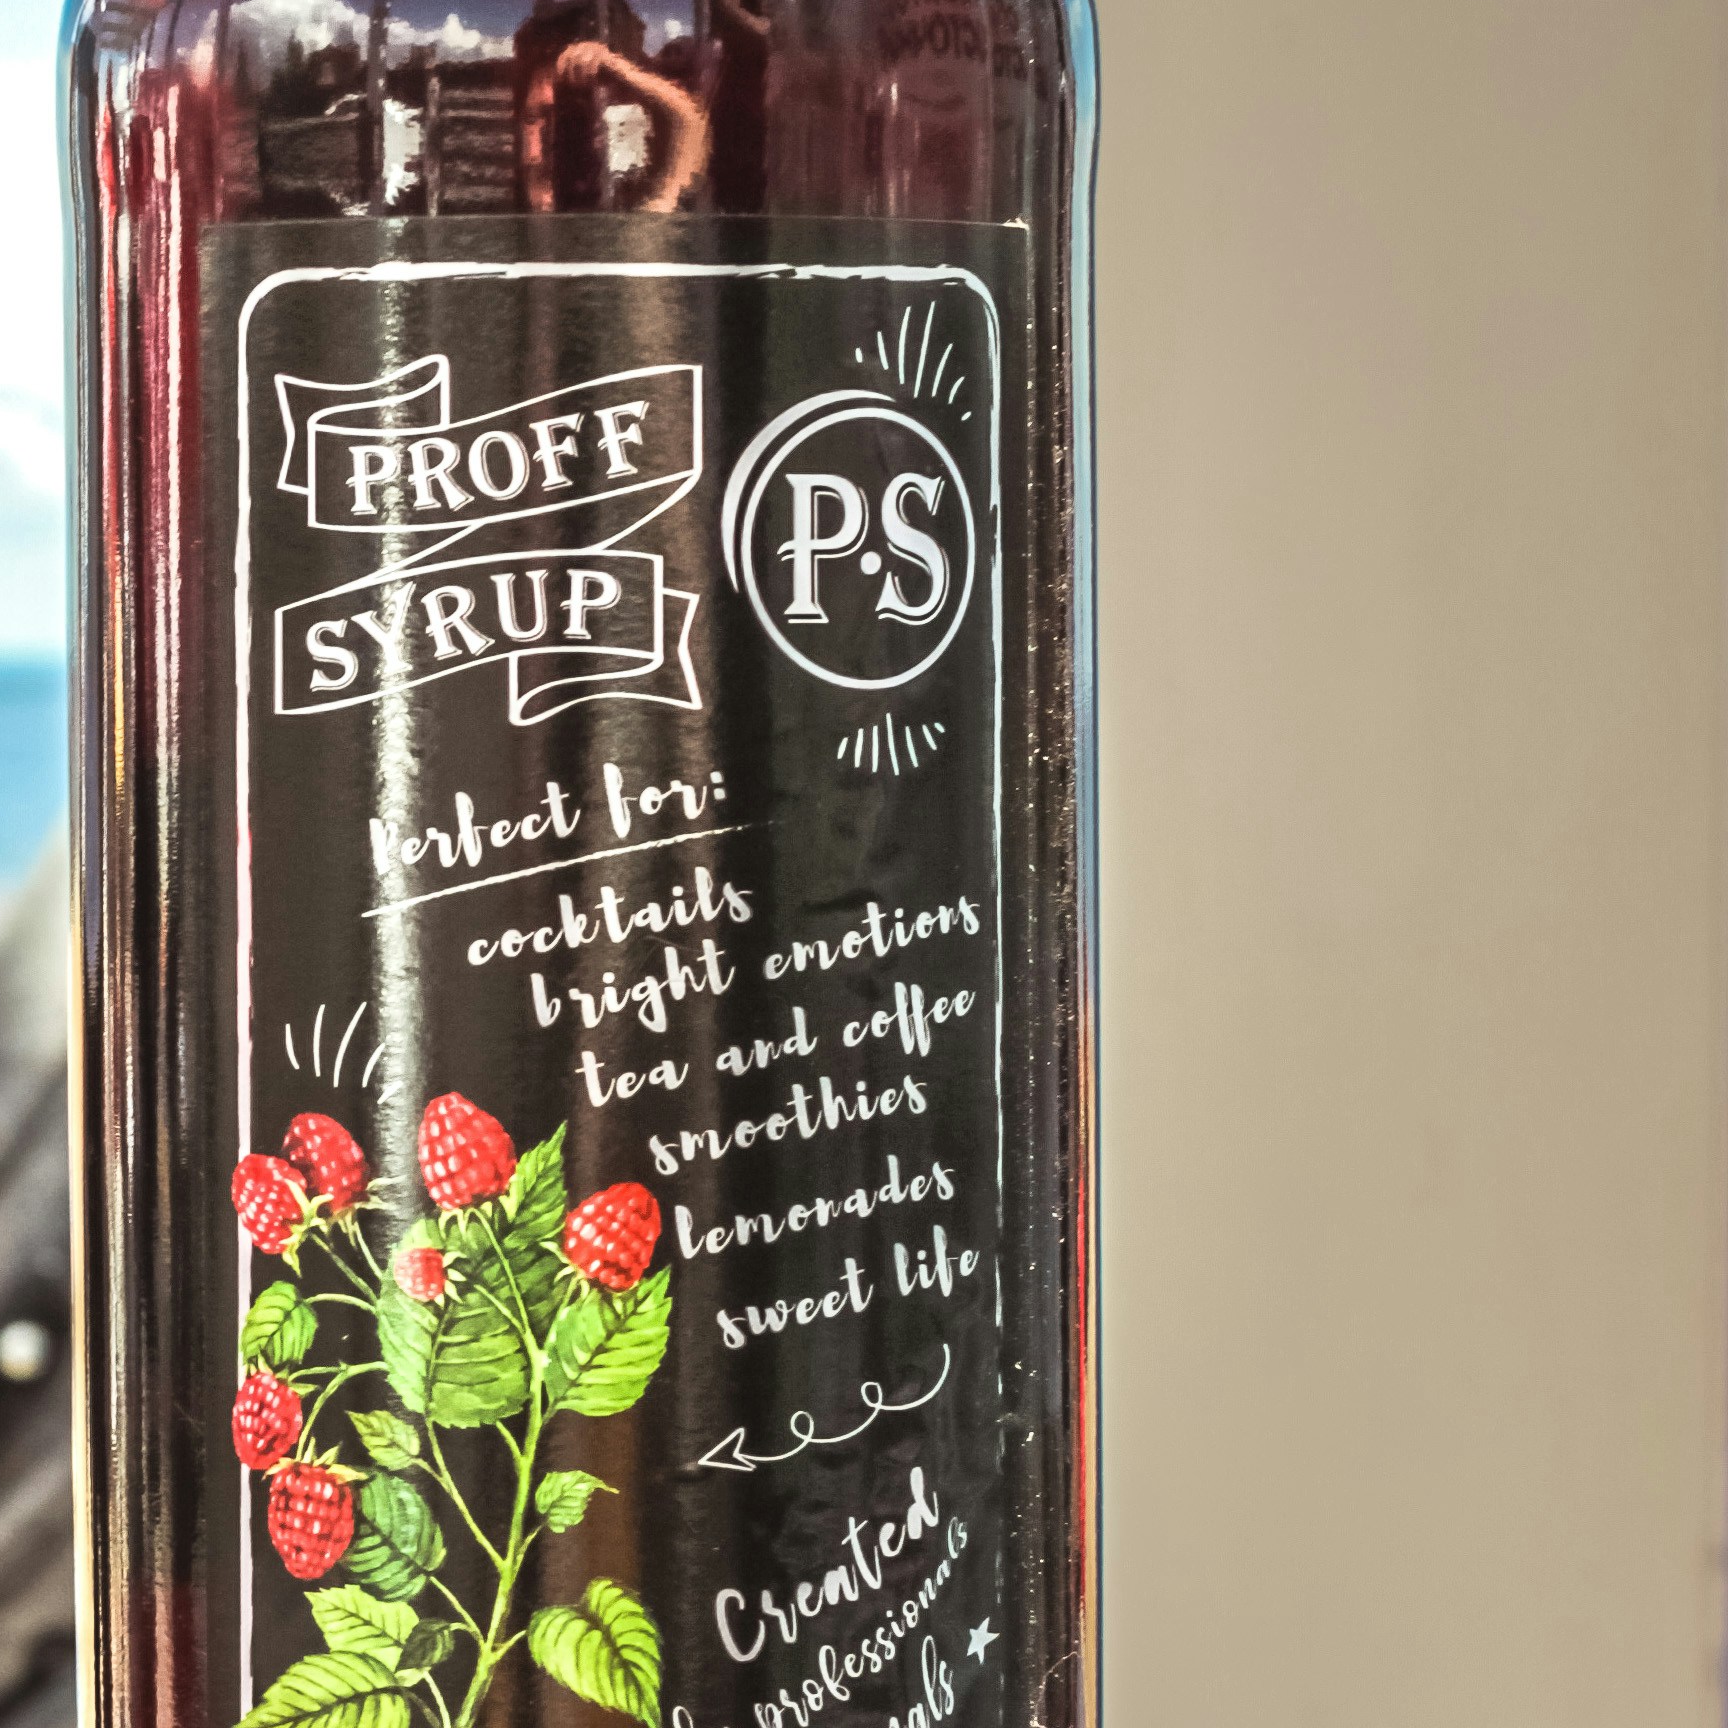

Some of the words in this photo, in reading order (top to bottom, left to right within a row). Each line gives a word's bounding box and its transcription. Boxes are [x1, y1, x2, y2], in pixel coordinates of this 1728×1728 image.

[346, 399, 652, 518] PROFF
[305, 567, 625, 693] SYRUP
[603, 762, 728, 839] for:
[467, 866, 755, 967] cocktails
[530, 938, 736, 1033] bright
[763, 894, 981, 981] emotions
[575, 1050, 689, 1108] tea
[715, 1006, 818, 1078] and
[842, 981, 977, 1058] coffee
[648, 1074, 928, 1176] smoothies
[674, 1154, 955, 1260] lemonades
[715, 1257, 874, 1350] sweet
[893, 1224, 980, 1298] life
[714, 1465, 943, 1662] Created
